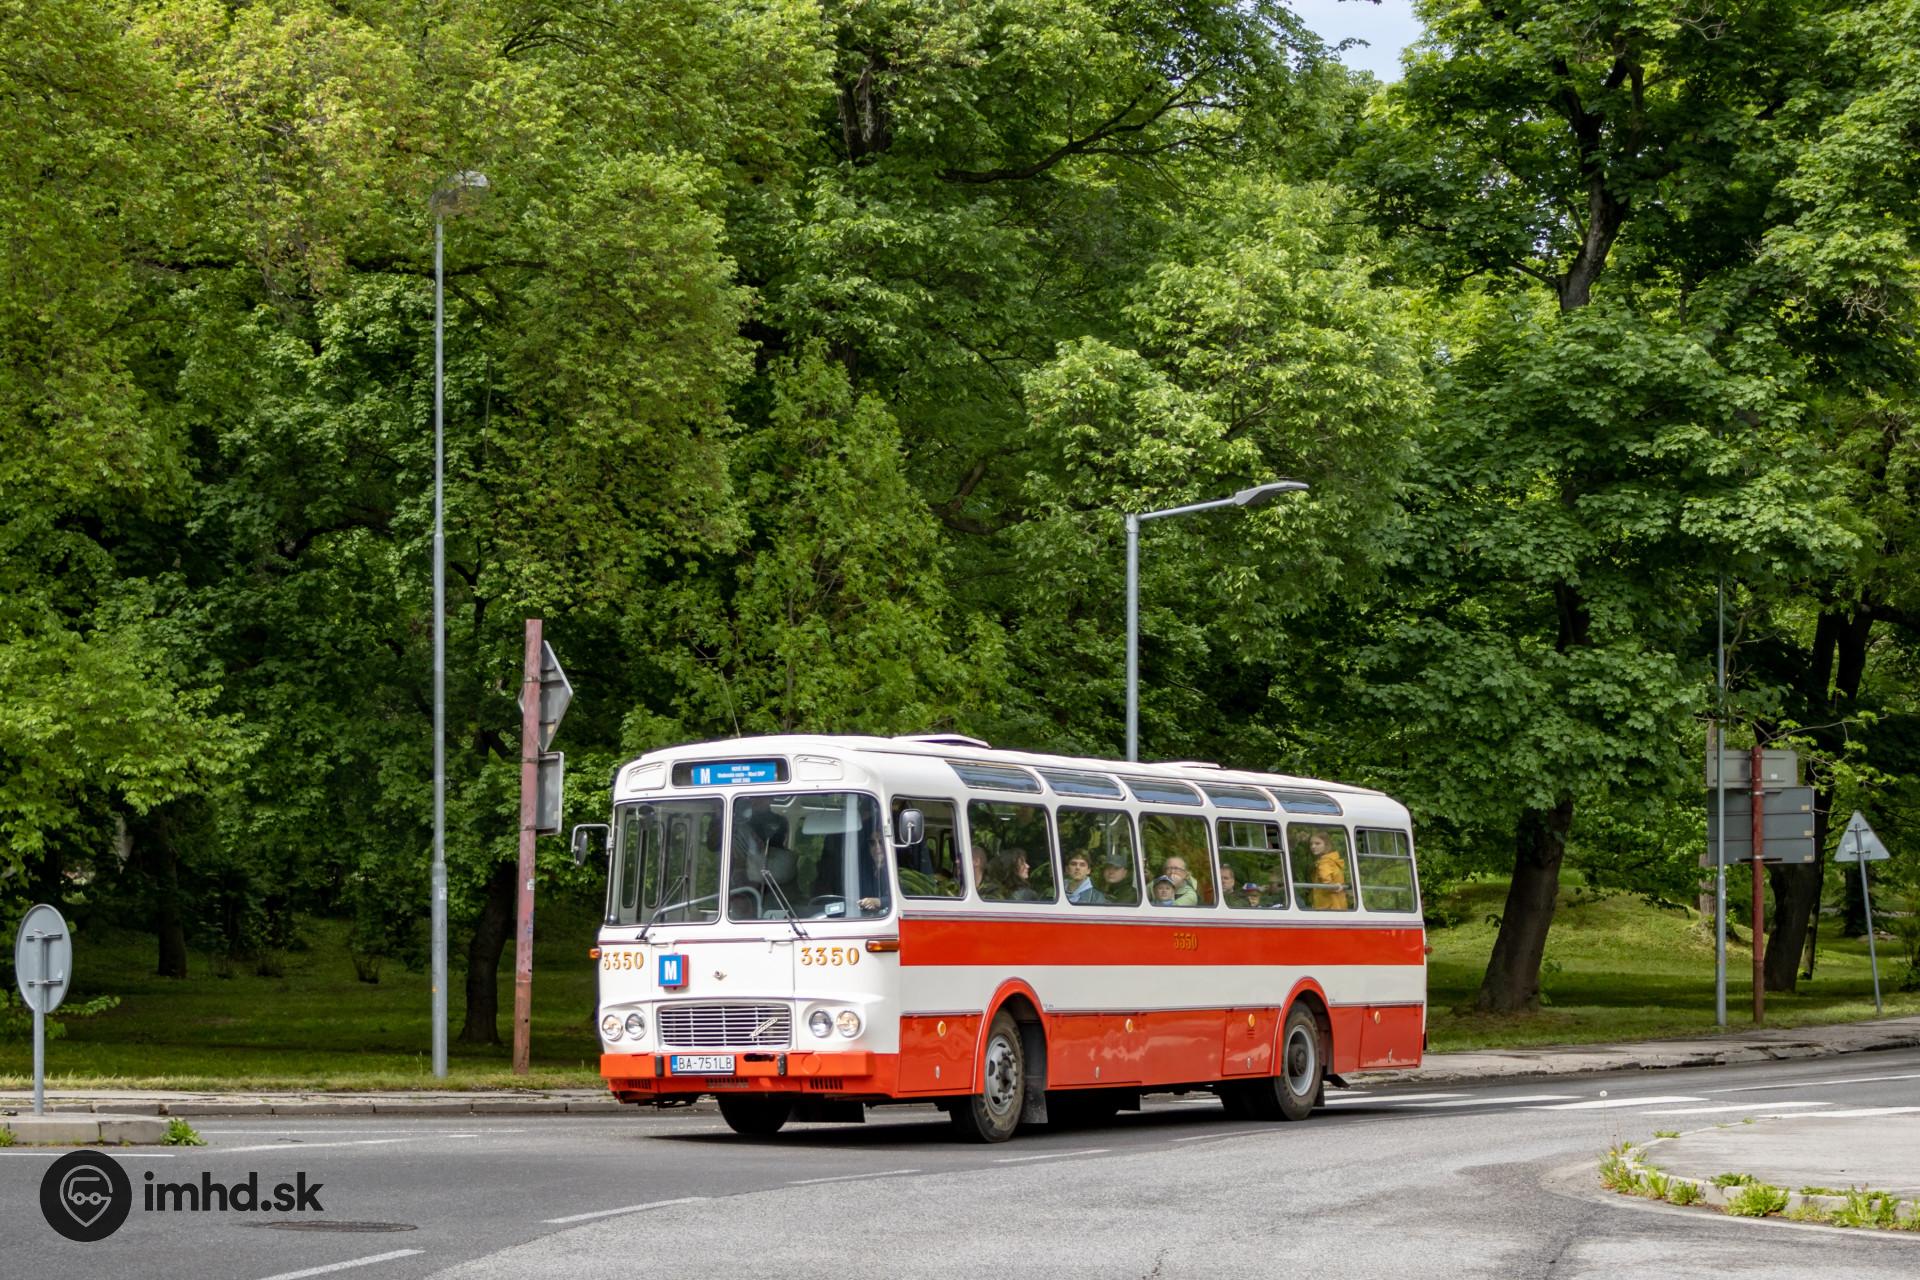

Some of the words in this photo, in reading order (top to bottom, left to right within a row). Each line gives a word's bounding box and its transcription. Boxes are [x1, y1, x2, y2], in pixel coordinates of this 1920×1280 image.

[700, 768, 711, 784] M
[603, 952, 645, 970] 3350
[801, 947, 860, 966] 3350
[664, 960, 677, 981] M
[678, 1057, 733, 1070] BA-751LB
